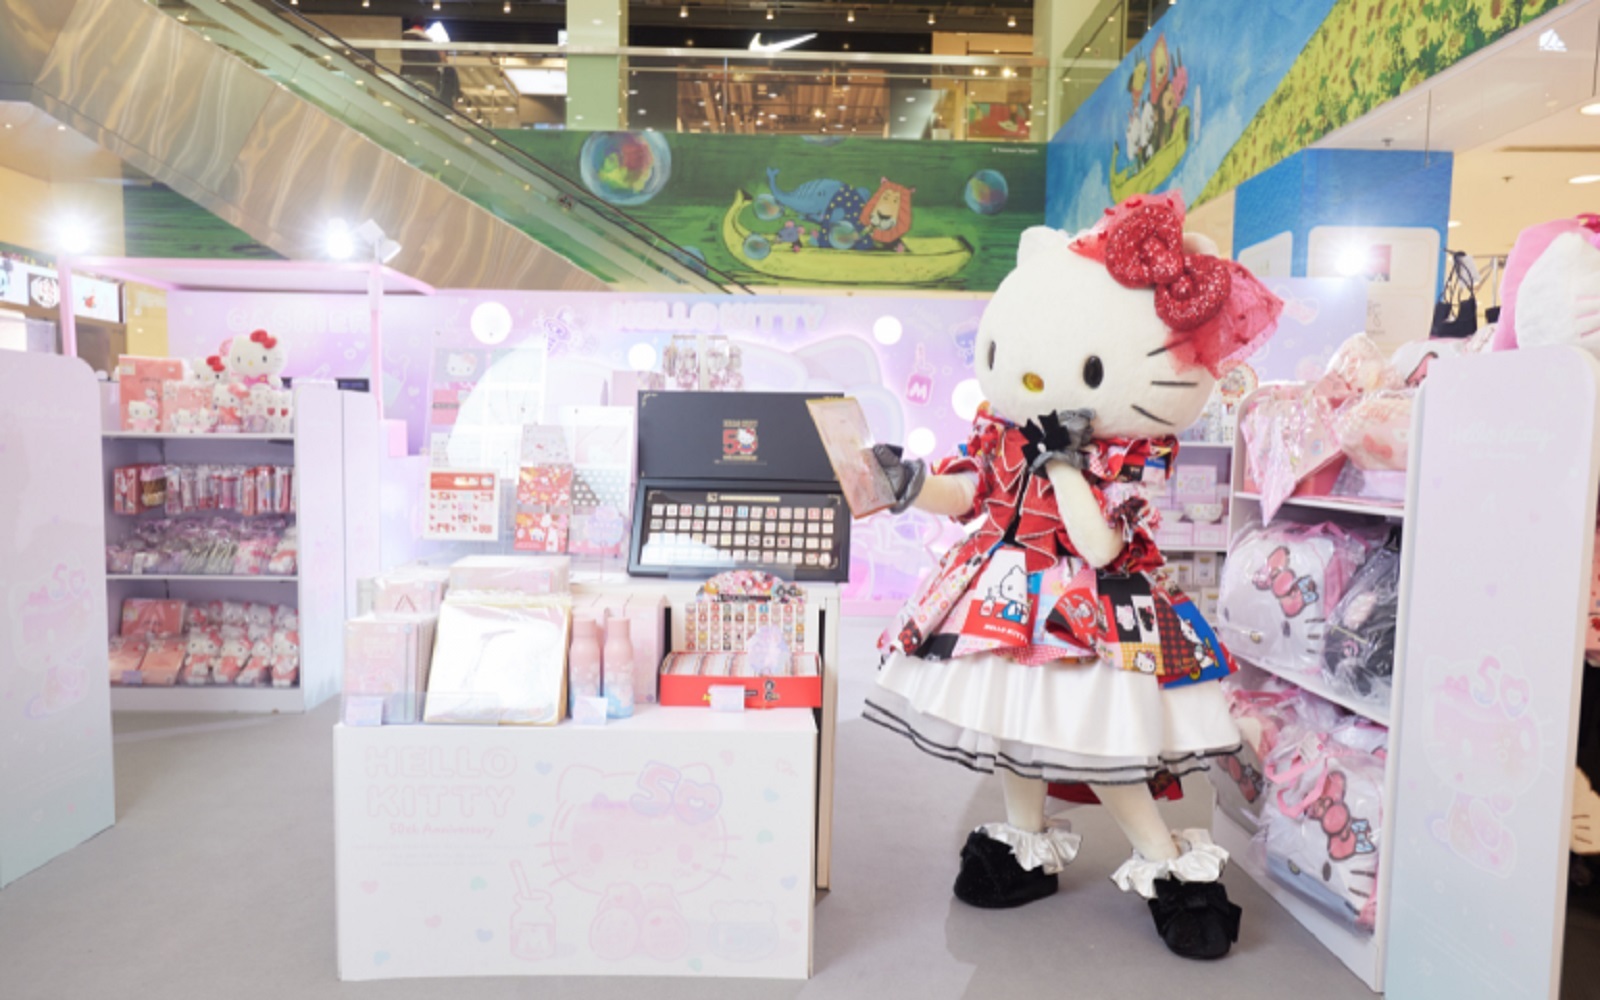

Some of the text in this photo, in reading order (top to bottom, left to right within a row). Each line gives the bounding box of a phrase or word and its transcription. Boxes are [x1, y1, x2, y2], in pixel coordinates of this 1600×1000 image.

[611, 300, 826, 331] HELLO KITTY
[365, 745, 518, 779] HELLO
[366, 784, 516, 818] KITTY
[389, 822, 496, 840] 50th Anniversary
